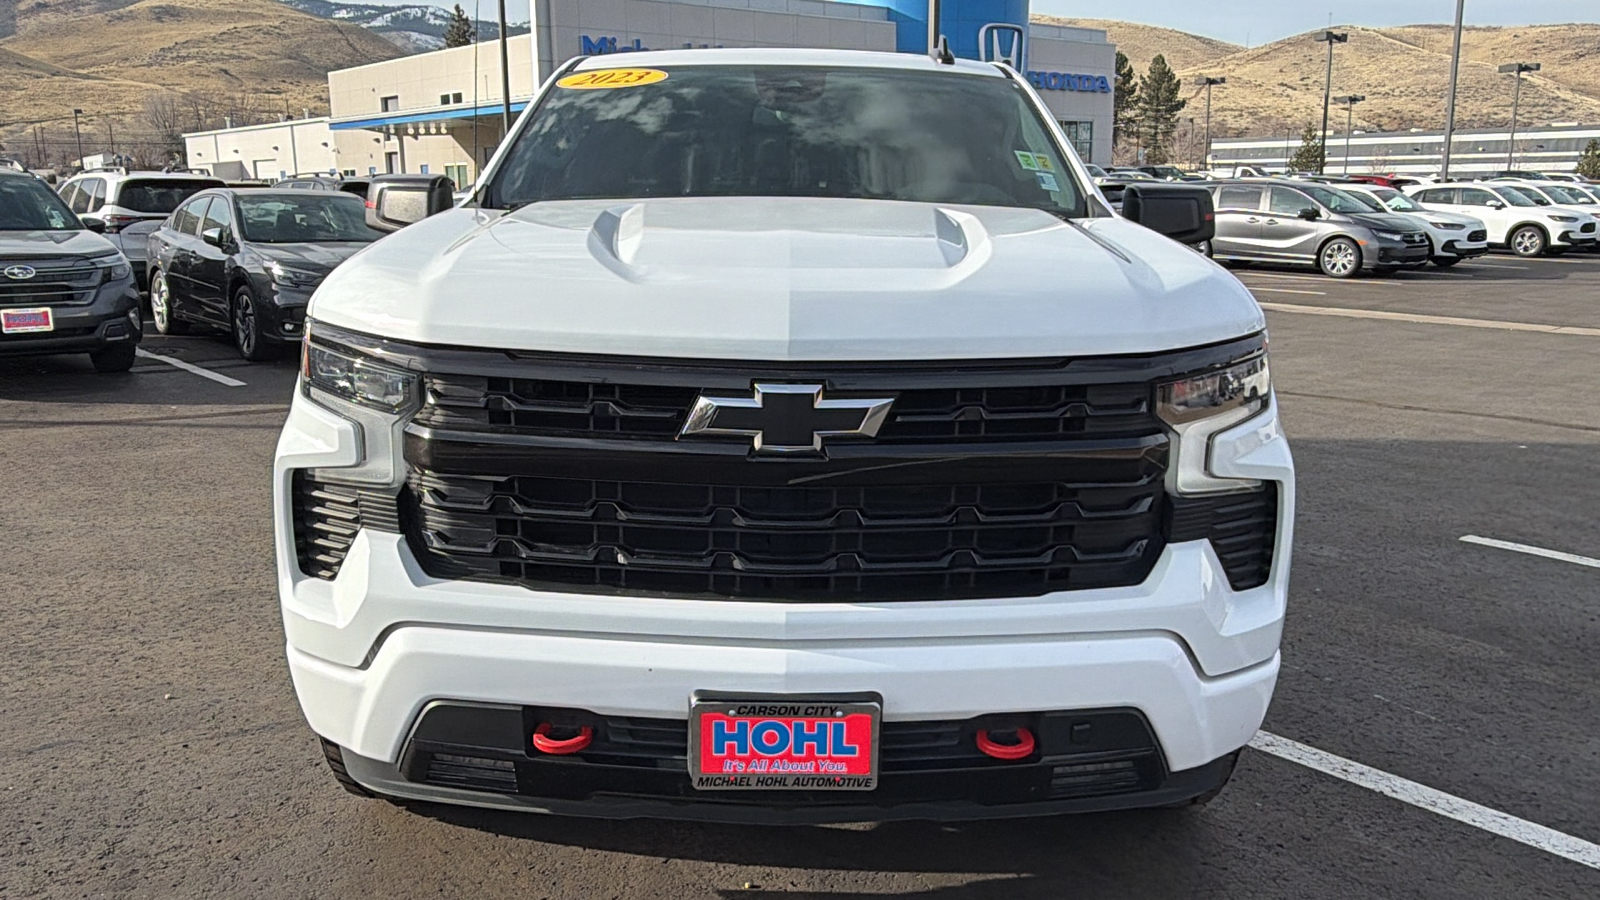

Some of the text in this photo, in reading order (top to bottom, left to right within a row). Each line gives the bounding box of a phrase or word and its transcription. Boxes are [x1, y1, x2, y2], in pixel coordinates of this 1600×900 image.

[570, 71, 651, 86] 2023
[1027, 71, 1111, 93] HONDA
[737, 705, 838, 716] CARSON CITY
[712, 720, 858, 756] HOHL
[723, 759, 745, 772] It's
[748, 759, 767, 772] All
[770, 759, 816, 772] About
[697, 777, 872, 788] MICHAEL HOHL AUTOMOTIVE
